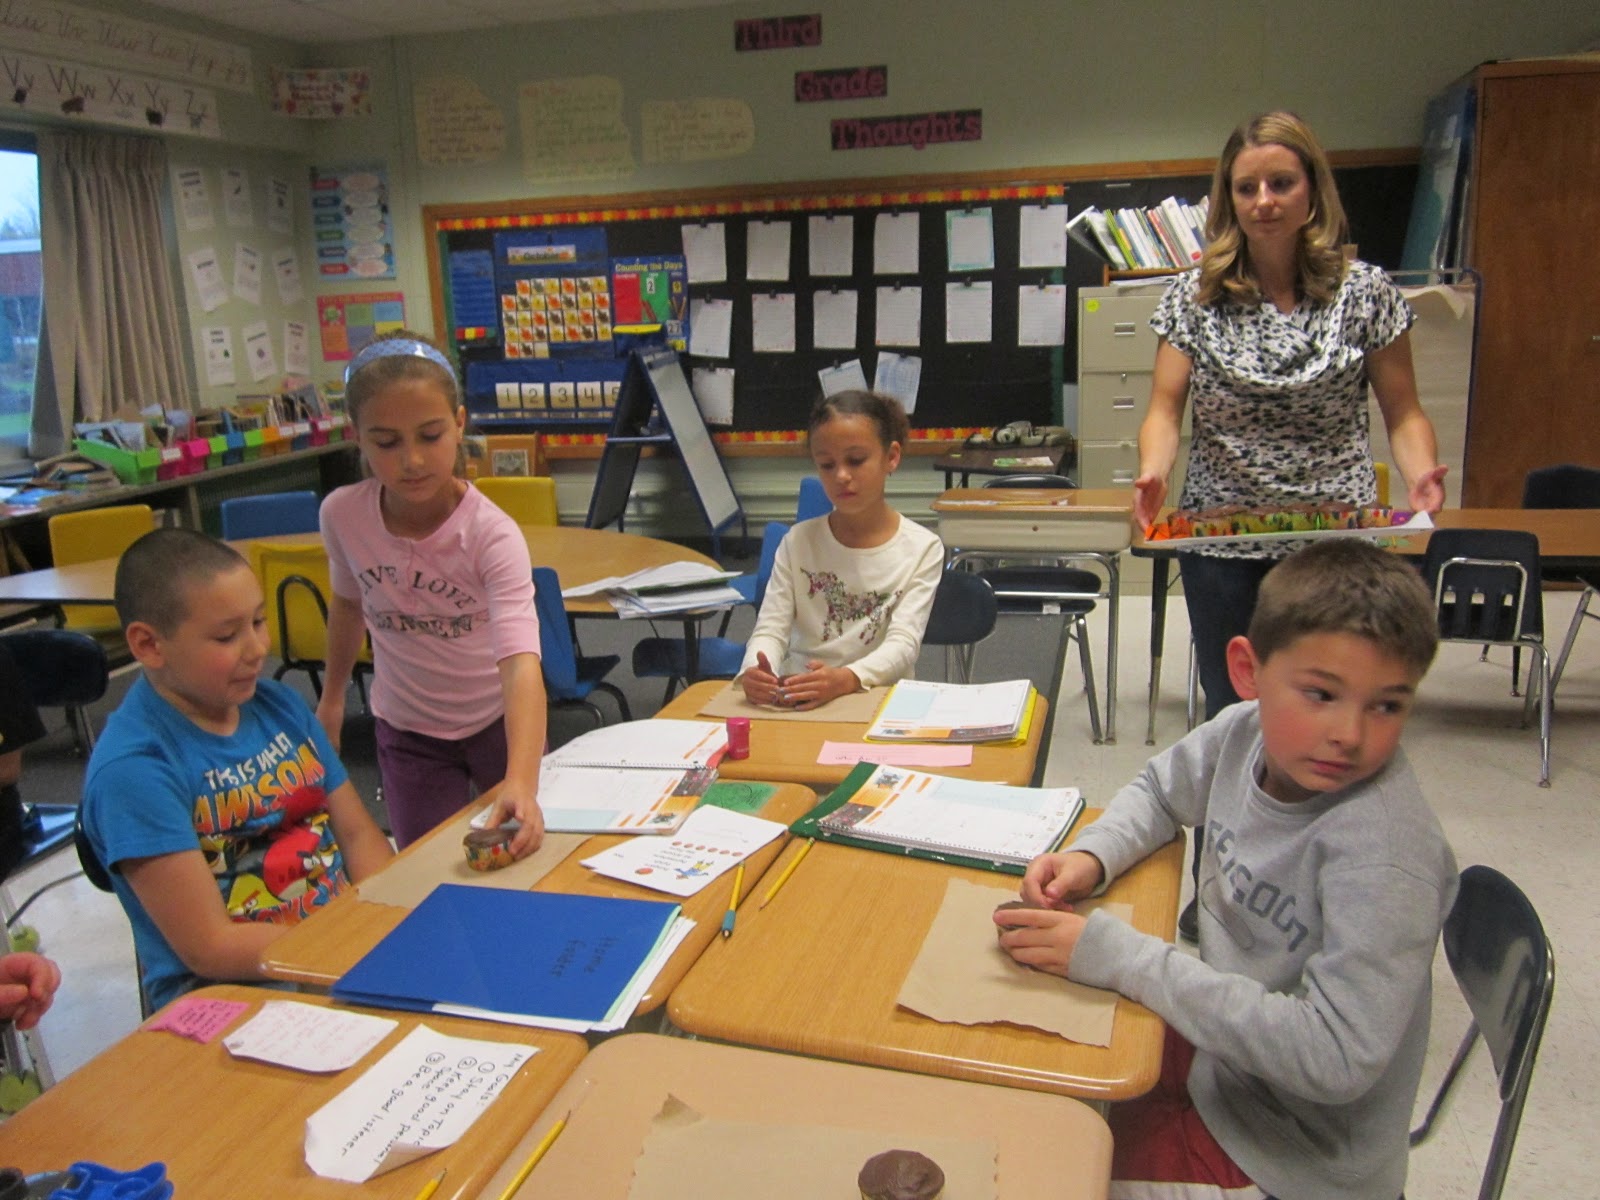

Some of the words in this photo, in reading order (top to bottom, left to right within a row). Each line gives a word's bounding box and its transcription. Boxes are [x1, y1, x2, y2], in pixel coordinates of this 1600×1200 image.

[736, 15, 821, 50] Third
[795, 66, 887, 102] Grade
[831, 110, 982, 150] Thoughts
[615, 263, 648, 273] Counting
[663, 261, 683, 271] Days
[558, 386, 569, 403] 3
[583, 386, 596, 403] 4
[411, 1064, 433, 1078] Be
[434, 1070, 463, 1093] Keep
[381, 1087, 405, 1113] good
[411, 1094, 438, 1121] good
[439, 1101, 455, 1116] on
[341, 1113, 385, 1157] listener
[413, 1118, 445, 1147] Topic
